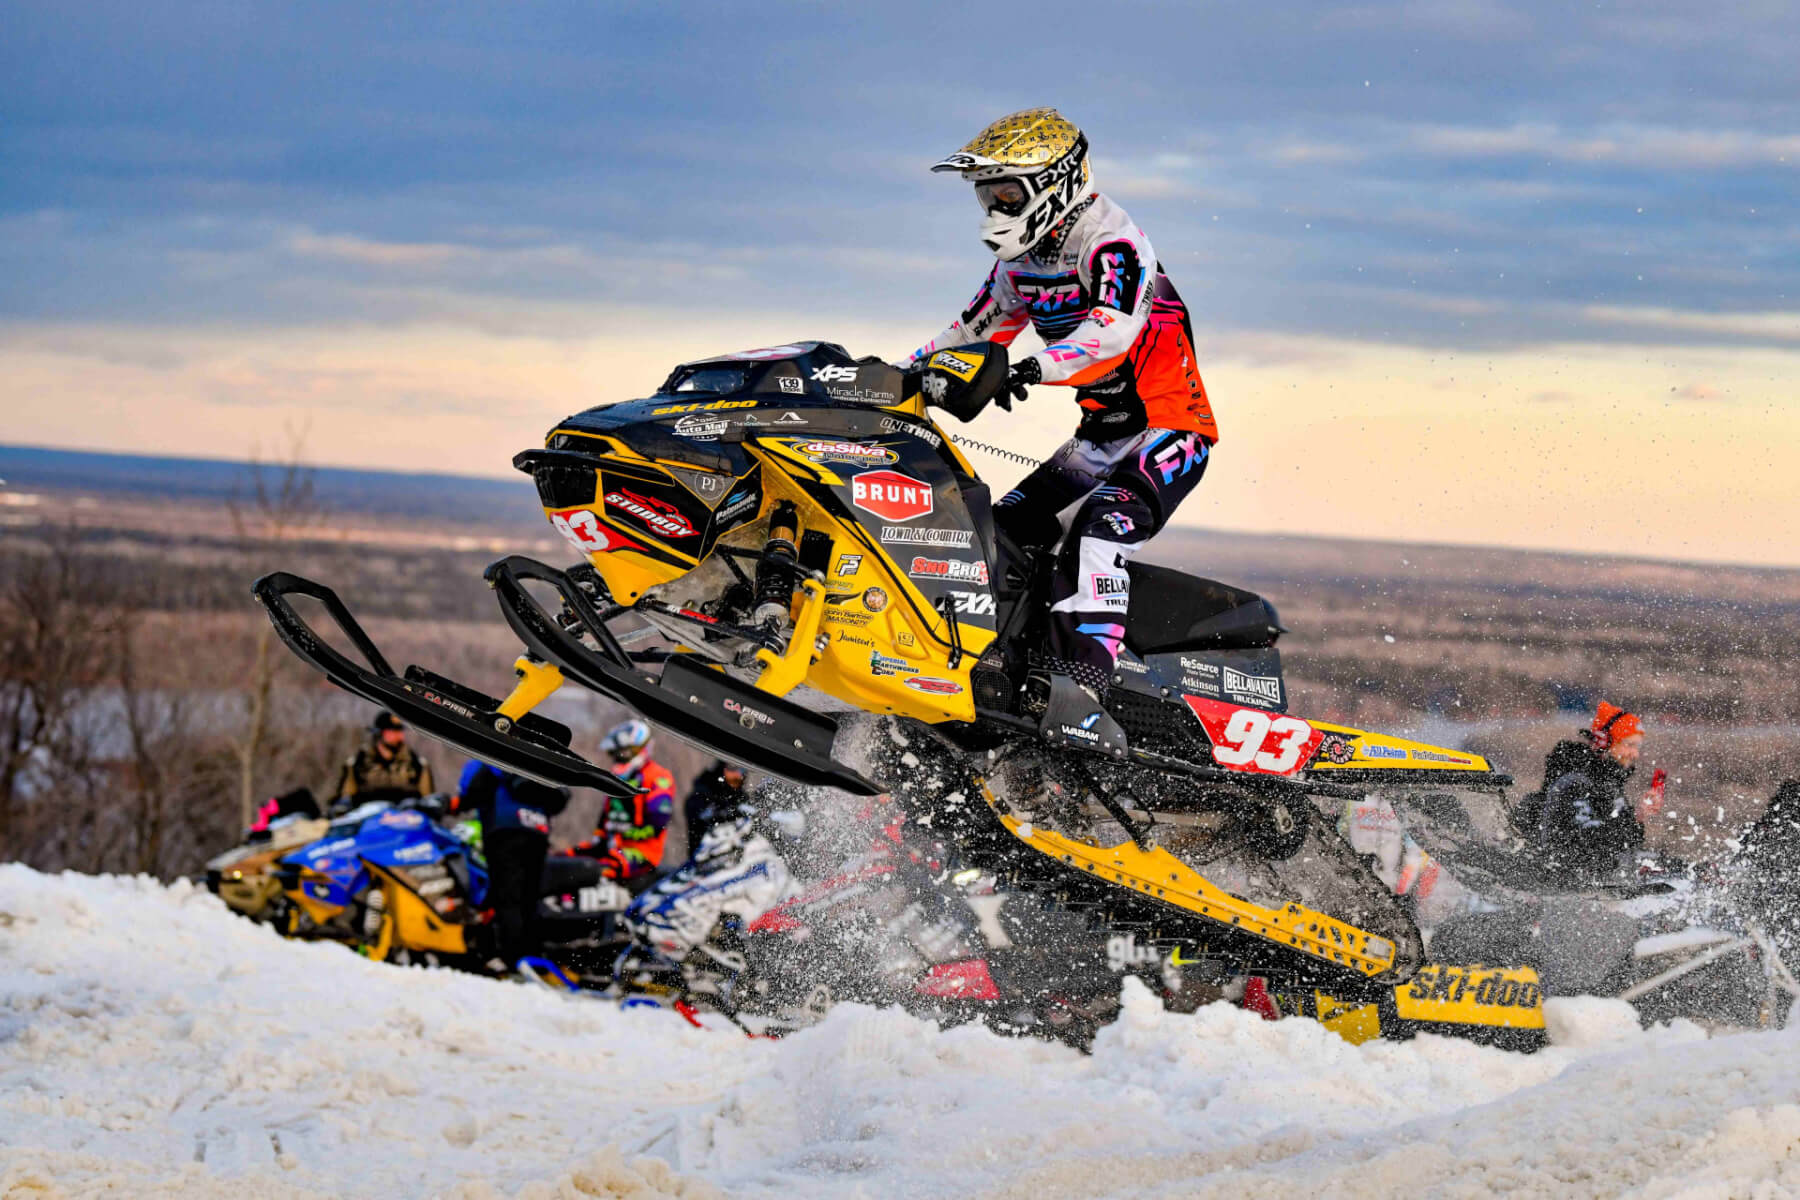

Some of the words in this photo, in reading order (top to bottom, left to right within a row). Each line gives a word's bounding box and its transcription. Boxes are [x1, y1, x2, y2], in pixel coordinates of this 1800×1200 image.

[810, 364, 860, 382] XPS
[782, 378, 799, 388] 139
[826, 385, 863, 398] Miracle
[865, 388, 895, 400] Farms
[701, 476, 717, 491] PJ
[855, 482, 933, 506] BRUNT
[1181, 676, 1219, 693] Atkinson
[1226, 675, 1279, 698] BELLAVANCE
[1061, 725, 1100, 742] WABAM
[1214, 709, 1314, 773] 93
